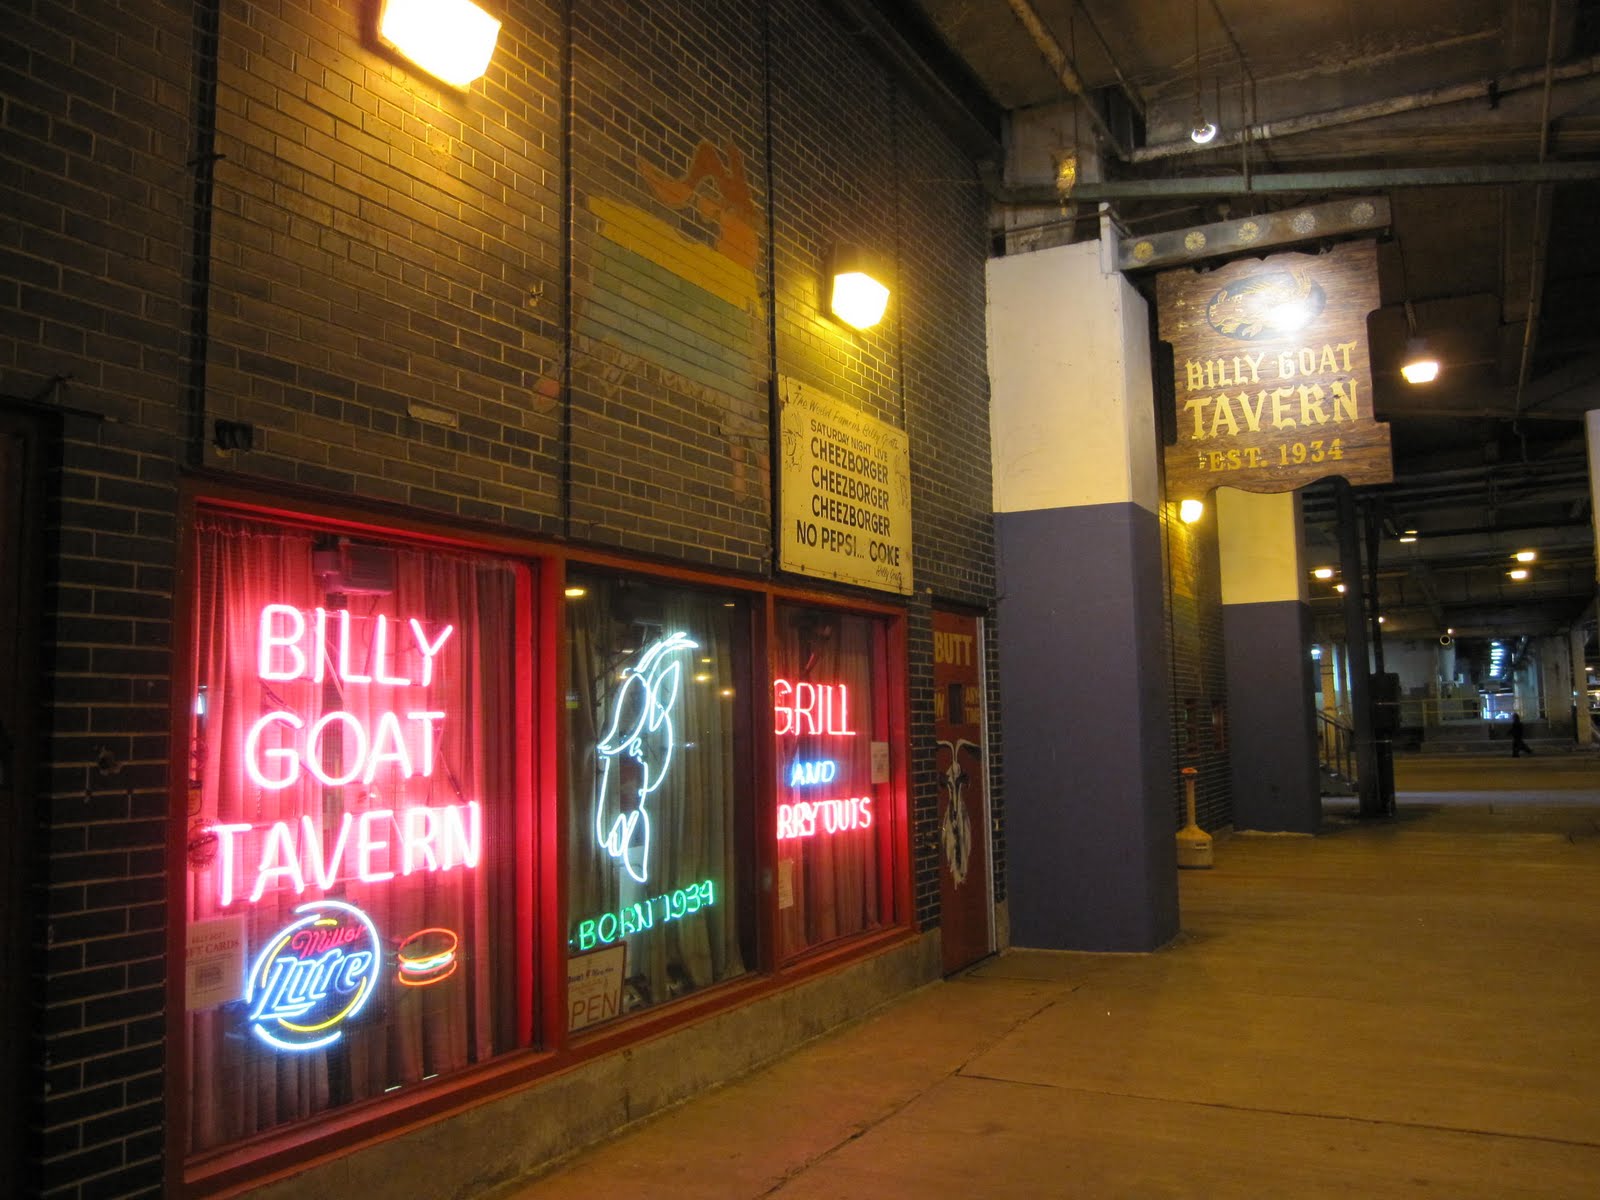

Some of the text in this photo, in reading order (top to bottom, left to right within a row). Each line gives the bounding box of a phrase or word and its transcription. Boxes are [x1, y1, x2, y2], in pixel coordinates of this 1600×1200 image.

[1185, 341, 1358, 392] BILLY GOAT
[1184, 378, 1360, 440] TAVERN
[810, 418, 888, 463] SATURDAY NIGHT LIVE
[810, 436, 889, 485] CHEEZBORGER
[1208, 438, 1344, 473] EST. 1934
[811, 465, 890, 512] CHEEZBORGER
[811, 494, 891, 538] CHEEZBORGER
[796, 519, 818, 548] NO
[869, 540, 900, 567] COKE
[259, 603, 454, 688] BILLY
[934, 630, 973, 667] BUTT
[774, 678, 857, 736] GRILL
[245, 710, 447, 790] GOAT
[791, 760, 837, 788] AND
[776, 801, 818, 840] RRY
[211, 800, 482, 907] TAVERN
[291, 924, 368, 960] Miller
[579, 900, 653, 951] BORN
[250, 948, 372, 1021] Lite
[570, 989, 618, 1029] PEN
